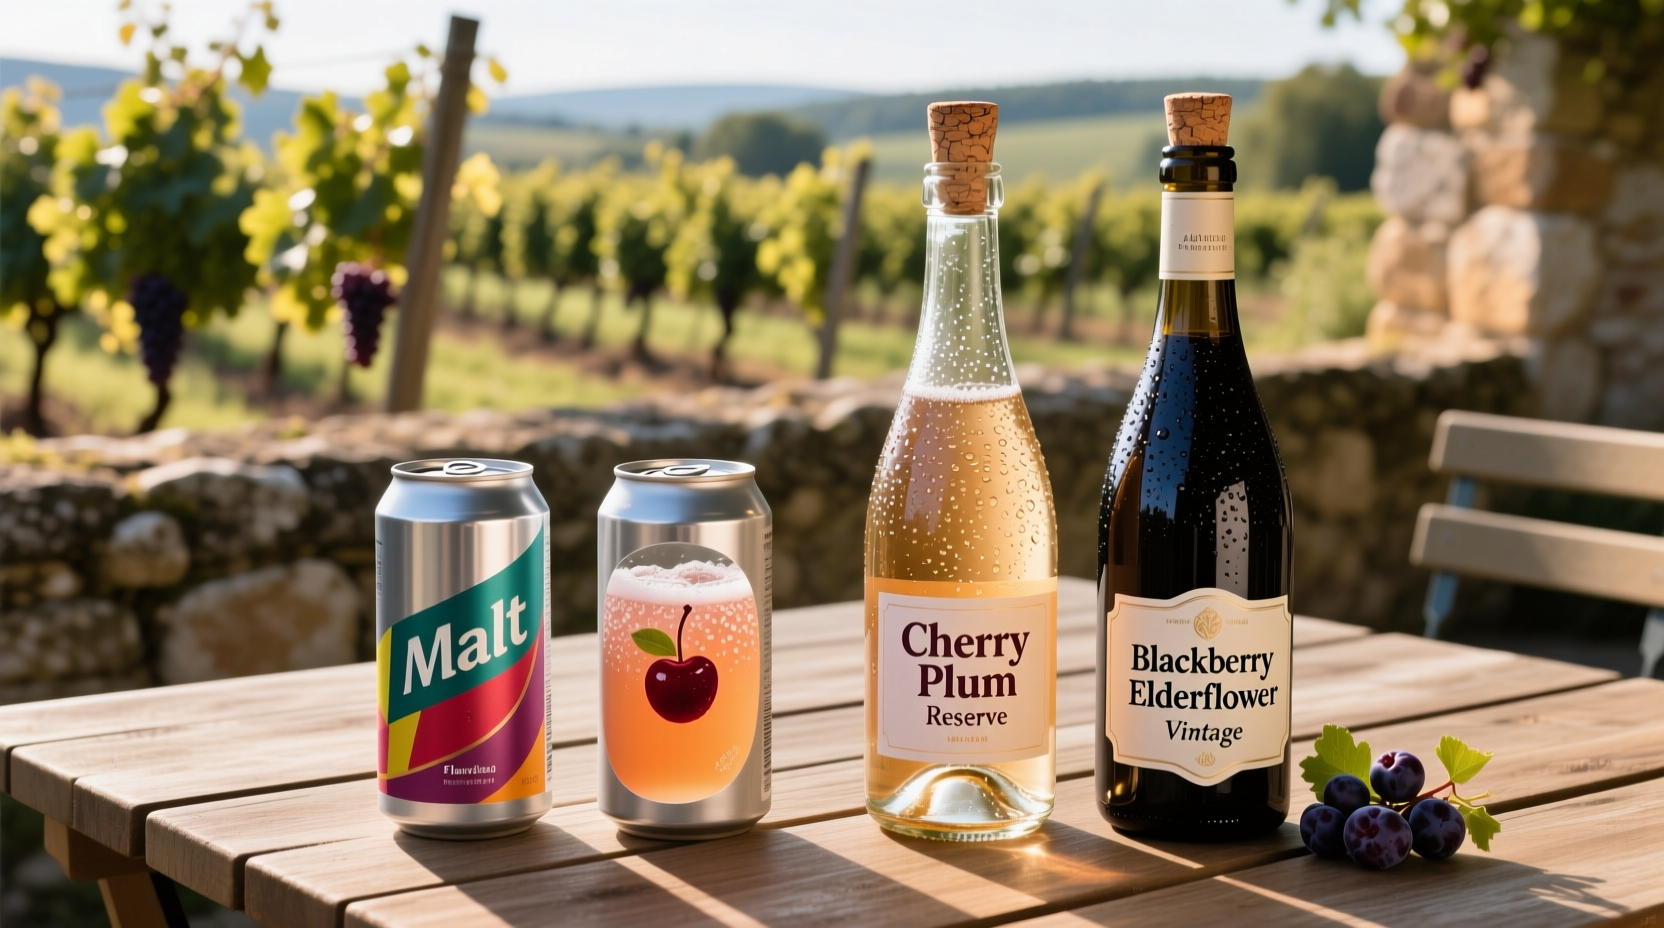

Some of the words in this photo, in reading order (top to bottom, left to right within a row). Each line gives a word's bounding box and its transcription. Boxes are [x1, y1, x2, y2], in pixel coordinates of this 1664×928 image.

[403, 595, 528, 695] Malt
[901, 621, 1030, 667] Cherry
[1131, 643, 1274, 681] Blackberry
[917, 663, 1018, 699] Plum
[1128, 678, 1279, 710] Elderflower
[926, 705, 1008, 727] Reserve
[1165, 719, 1244, 748] Vintage
